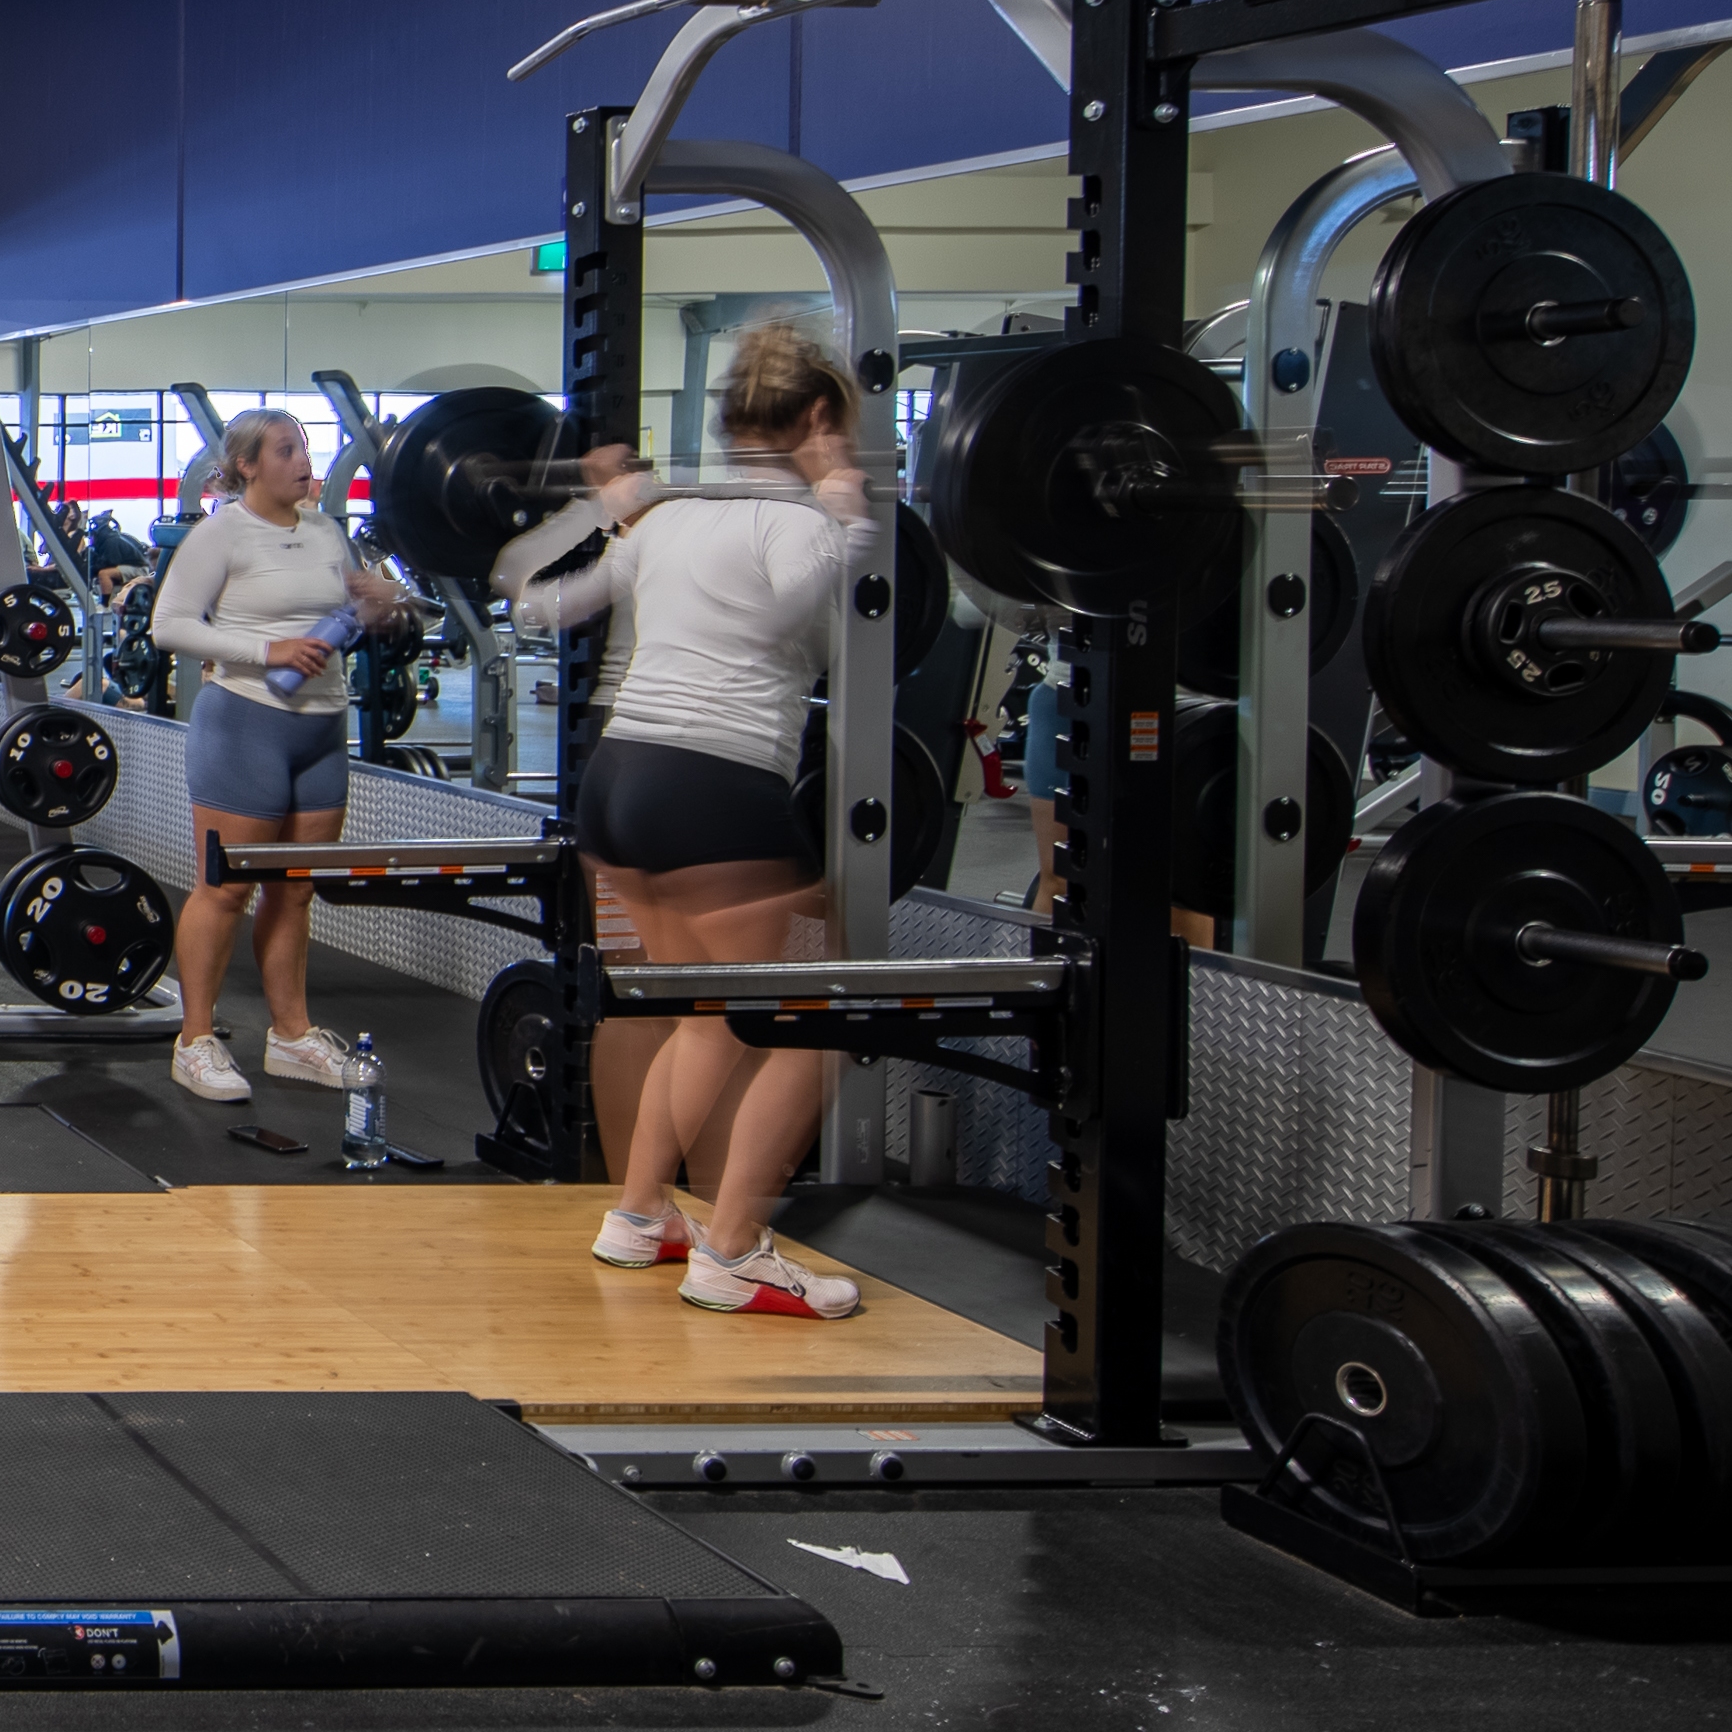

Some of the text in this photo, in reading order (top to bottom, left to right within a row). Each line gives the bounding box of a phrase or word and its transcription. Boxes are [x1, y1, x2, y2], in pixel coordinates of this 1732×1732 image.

[3, 594, 18, 608] 5
[1524, 580, 1563, 605] 2.5
[58, 624, 70, 637] 5
[9, 732, 32, 762] 10
[86, 732, 109, 761] 10
[27, 877, 63, 923] 20
[59, 980, 109, 1003] 20
[348, 1092, 373, 1141] pump
[86, 1628, 119, 1638] DON'T
